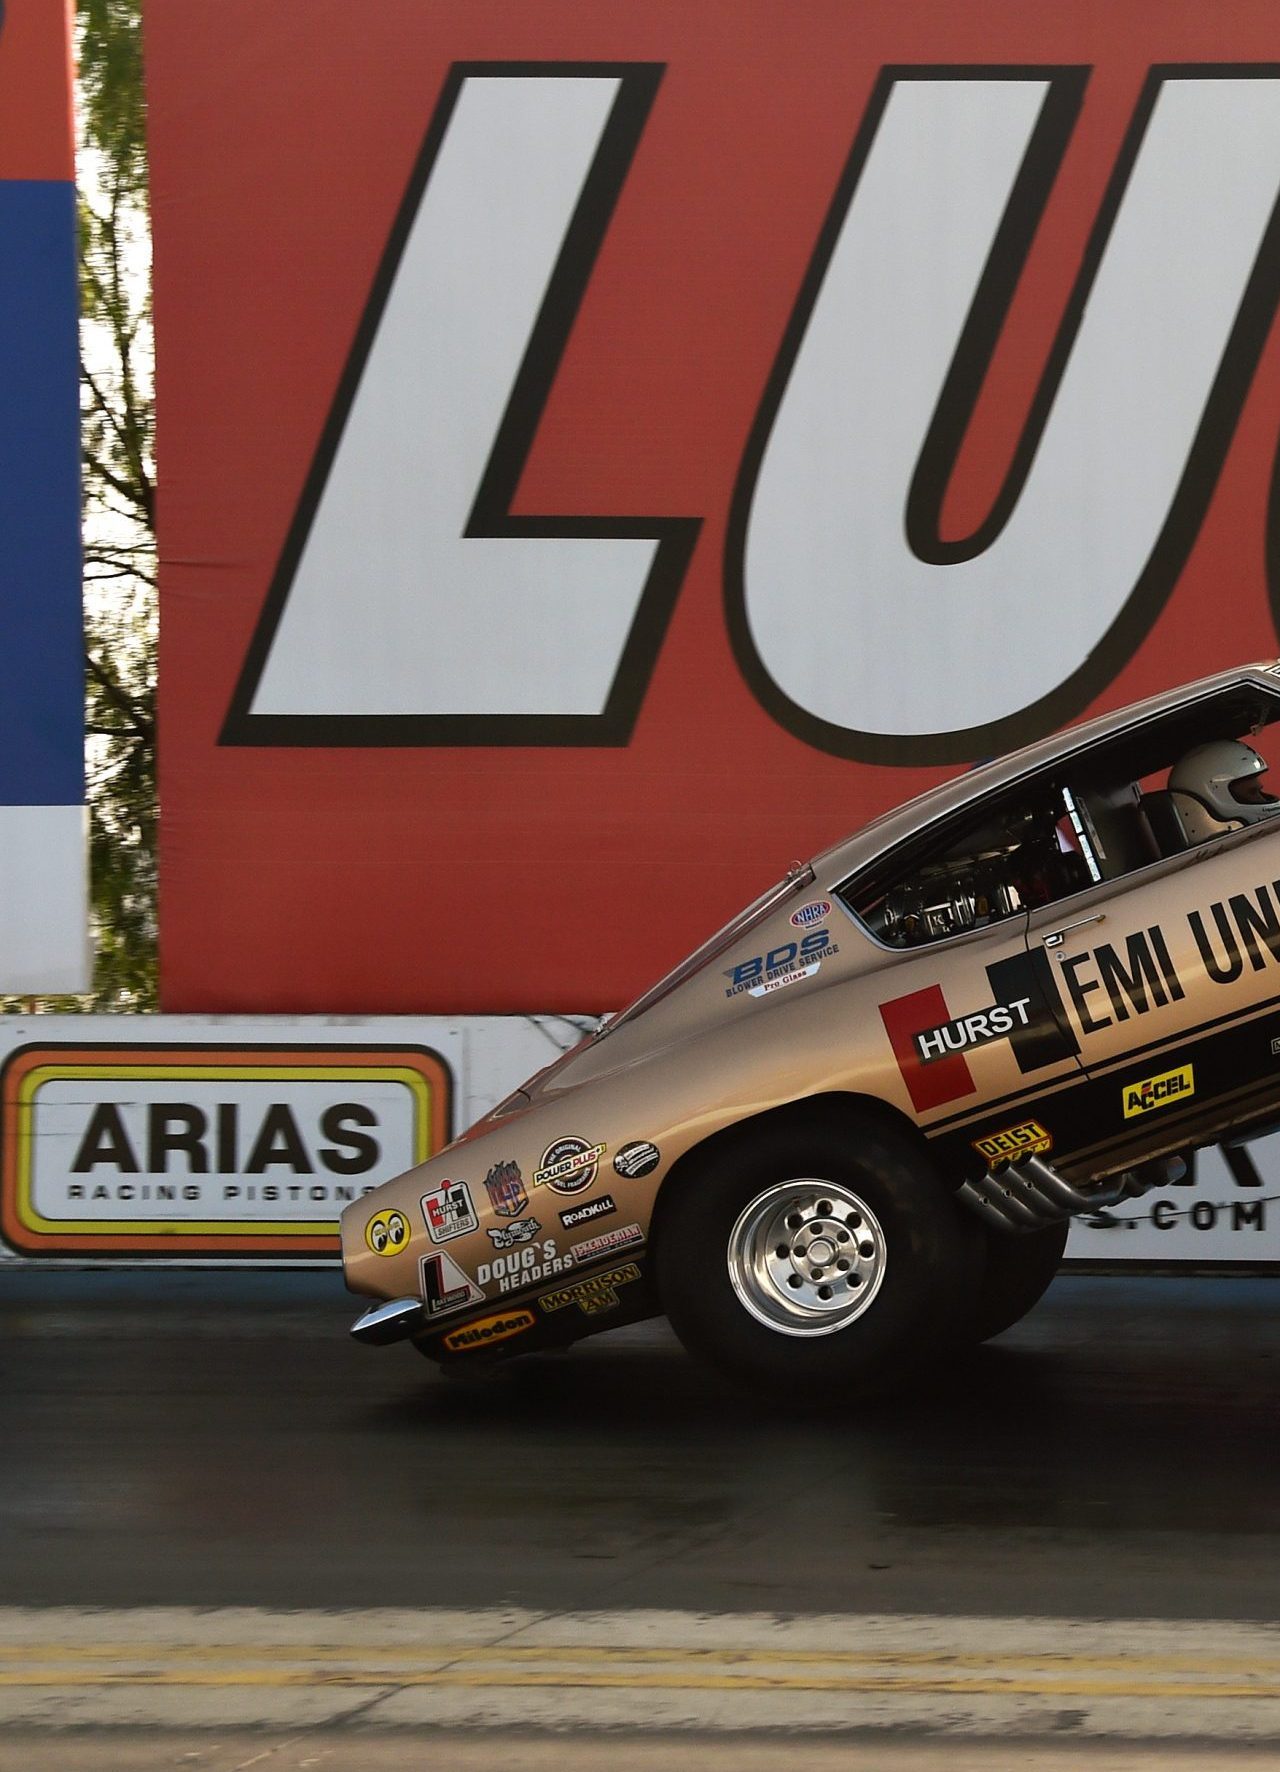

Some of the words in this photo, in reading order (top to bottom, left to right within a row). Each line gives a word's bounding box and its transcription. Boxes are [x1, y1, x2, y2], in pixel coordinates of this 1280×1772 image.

[796, 904, 827, 922] NHRA
[726, 976, 764, 998] BLOWER
[767, 962, 796, 982] DRIVE
[799, 944, 839, 967] SERVICE
[732, 929, 829, 985] BDS
[764, 981, 780, 991] Pro
[783, 970, 807, 983] Glass
[917, 997, 1031, 1059] HURST
[1127, 1073, 1190, 1111] ACCEL
[69, 1102, 381, 1175] ARIAS
[547, 1152, 556, 1164] THE
[555, 1143, 581, 1154] ORIGINAL
[979, 1124, 1041, 1156] DEIST
[536, 1161, 572, 1183] POWER
[573, 1151, 596, 1168] PLUS
[67, 1185, 201, 1201] RACING
[432, 1200, 463, 1217] HURST
[438, 1219, 470, 1236] SHIFTERS
[500, 1254, 573, 1293] HEADERS
[545, 1265, 637, 1309] MORRISON
[450, 1314, 534, 1347] Milodon
